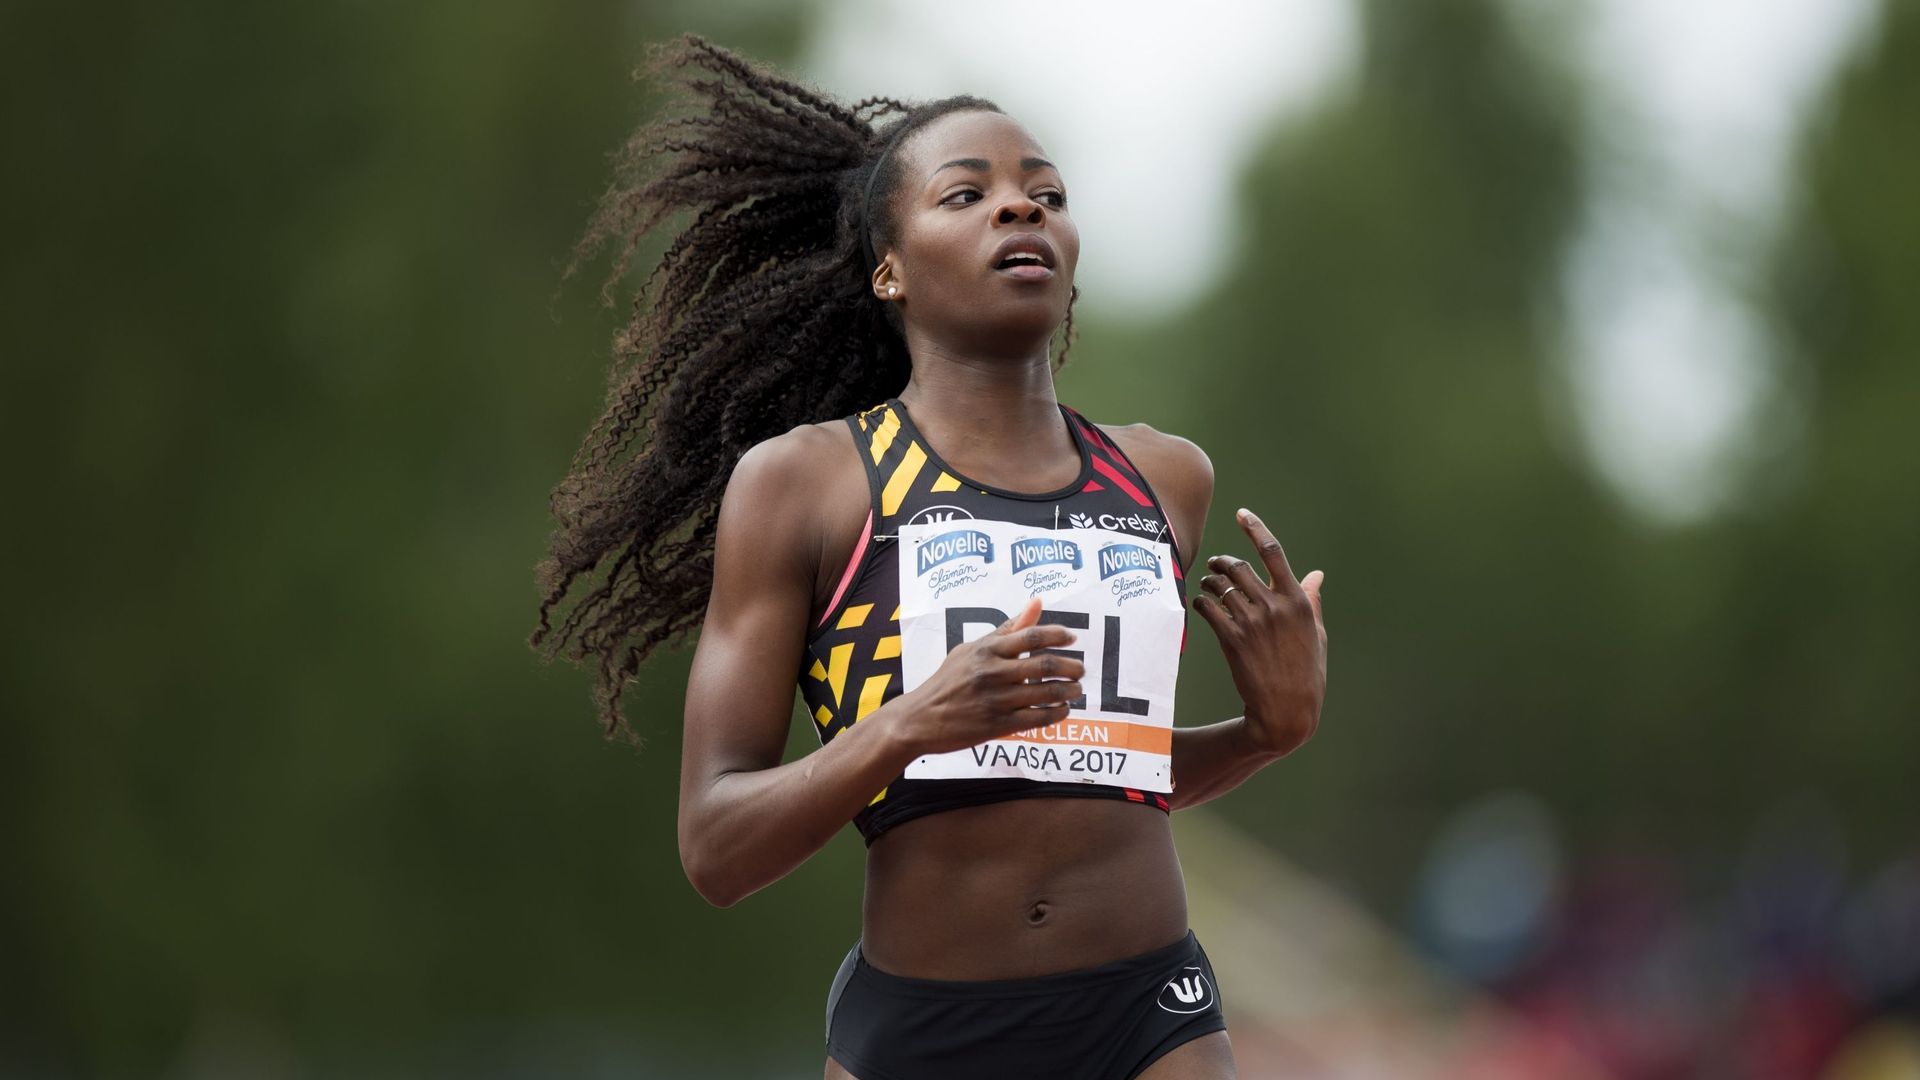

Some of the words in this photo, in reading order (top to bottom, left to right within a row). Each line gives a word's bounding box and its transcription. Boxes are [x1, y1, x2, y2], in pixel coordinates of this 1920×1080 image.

[921, 532, 988, 570] Novelle
[1015, 541, 1075, 569] Novelle
[1103, 548, 1156, 575] Novelle
[928, 563, 978, 589] Elämän
[1111, 576, 1151, 595] Elämän
[1041, 723, 1109, 743] CLEAN
[971, 745, 1061, 770] VAASA
[1069, 749, 1127, 775] 2017
